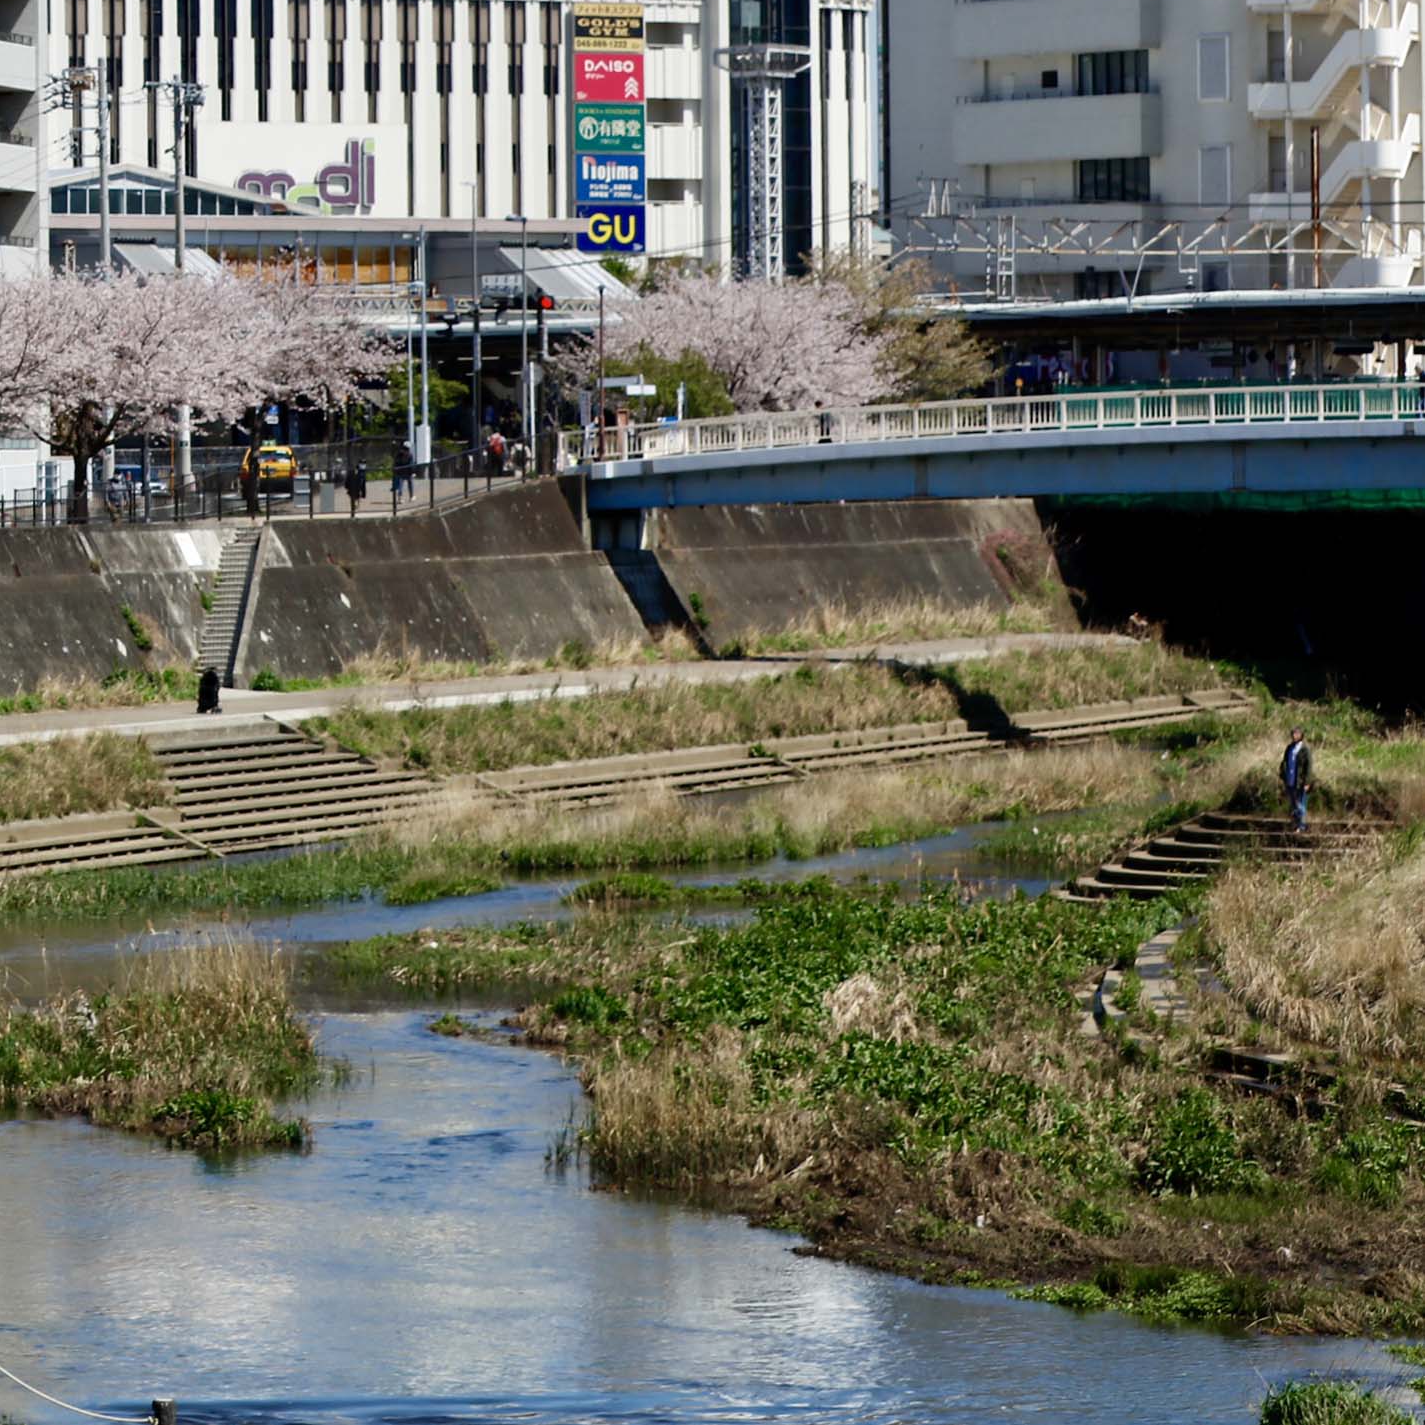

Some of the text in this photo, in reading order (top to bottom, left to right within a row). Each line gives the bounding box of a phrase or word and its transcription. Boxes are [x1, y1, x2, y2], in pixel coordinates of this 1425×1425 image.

[577, 17, 640, 28] GOLD'S
[589, 26, 630, 36] GYM
[584, 59, 635, 74] DAISO
[587, 212, 636, 245] GU
